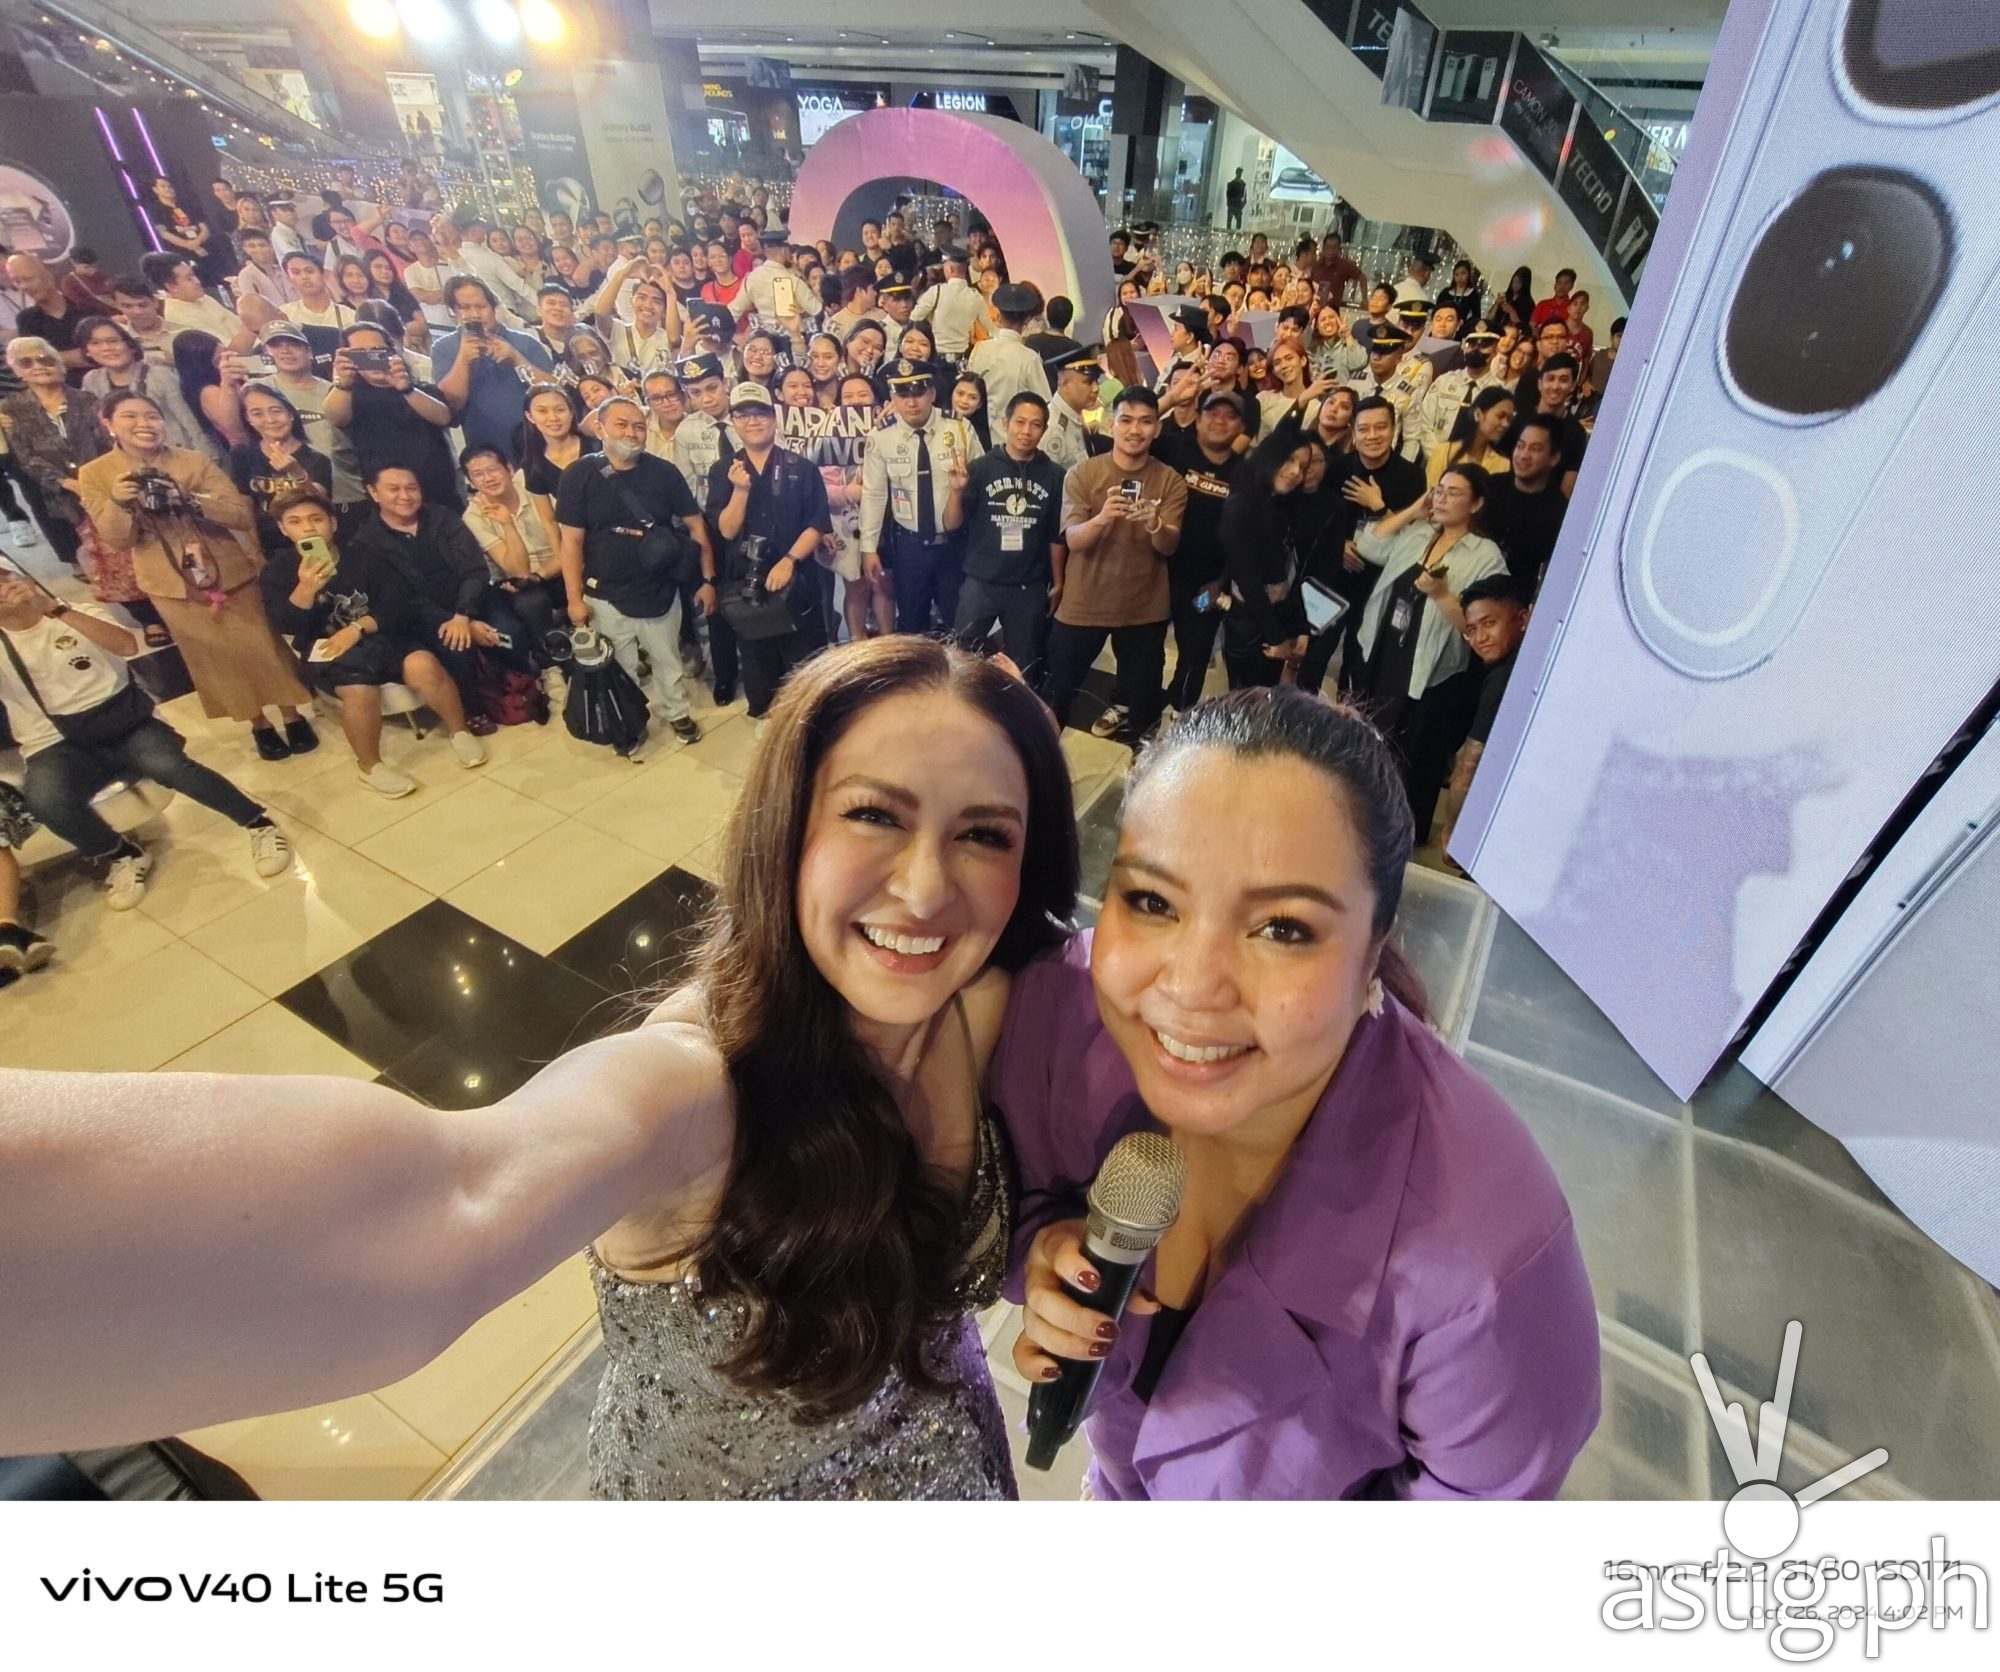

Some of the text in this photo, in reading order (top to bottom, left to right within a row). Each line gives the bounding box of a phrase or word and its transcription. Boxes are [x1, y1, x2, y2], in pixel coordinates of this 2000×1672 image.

[797, 94, 844, 113] YOGA
[935, 93, 986, 111] LEGION
[1569, 151, 1613, 214] TECNO
